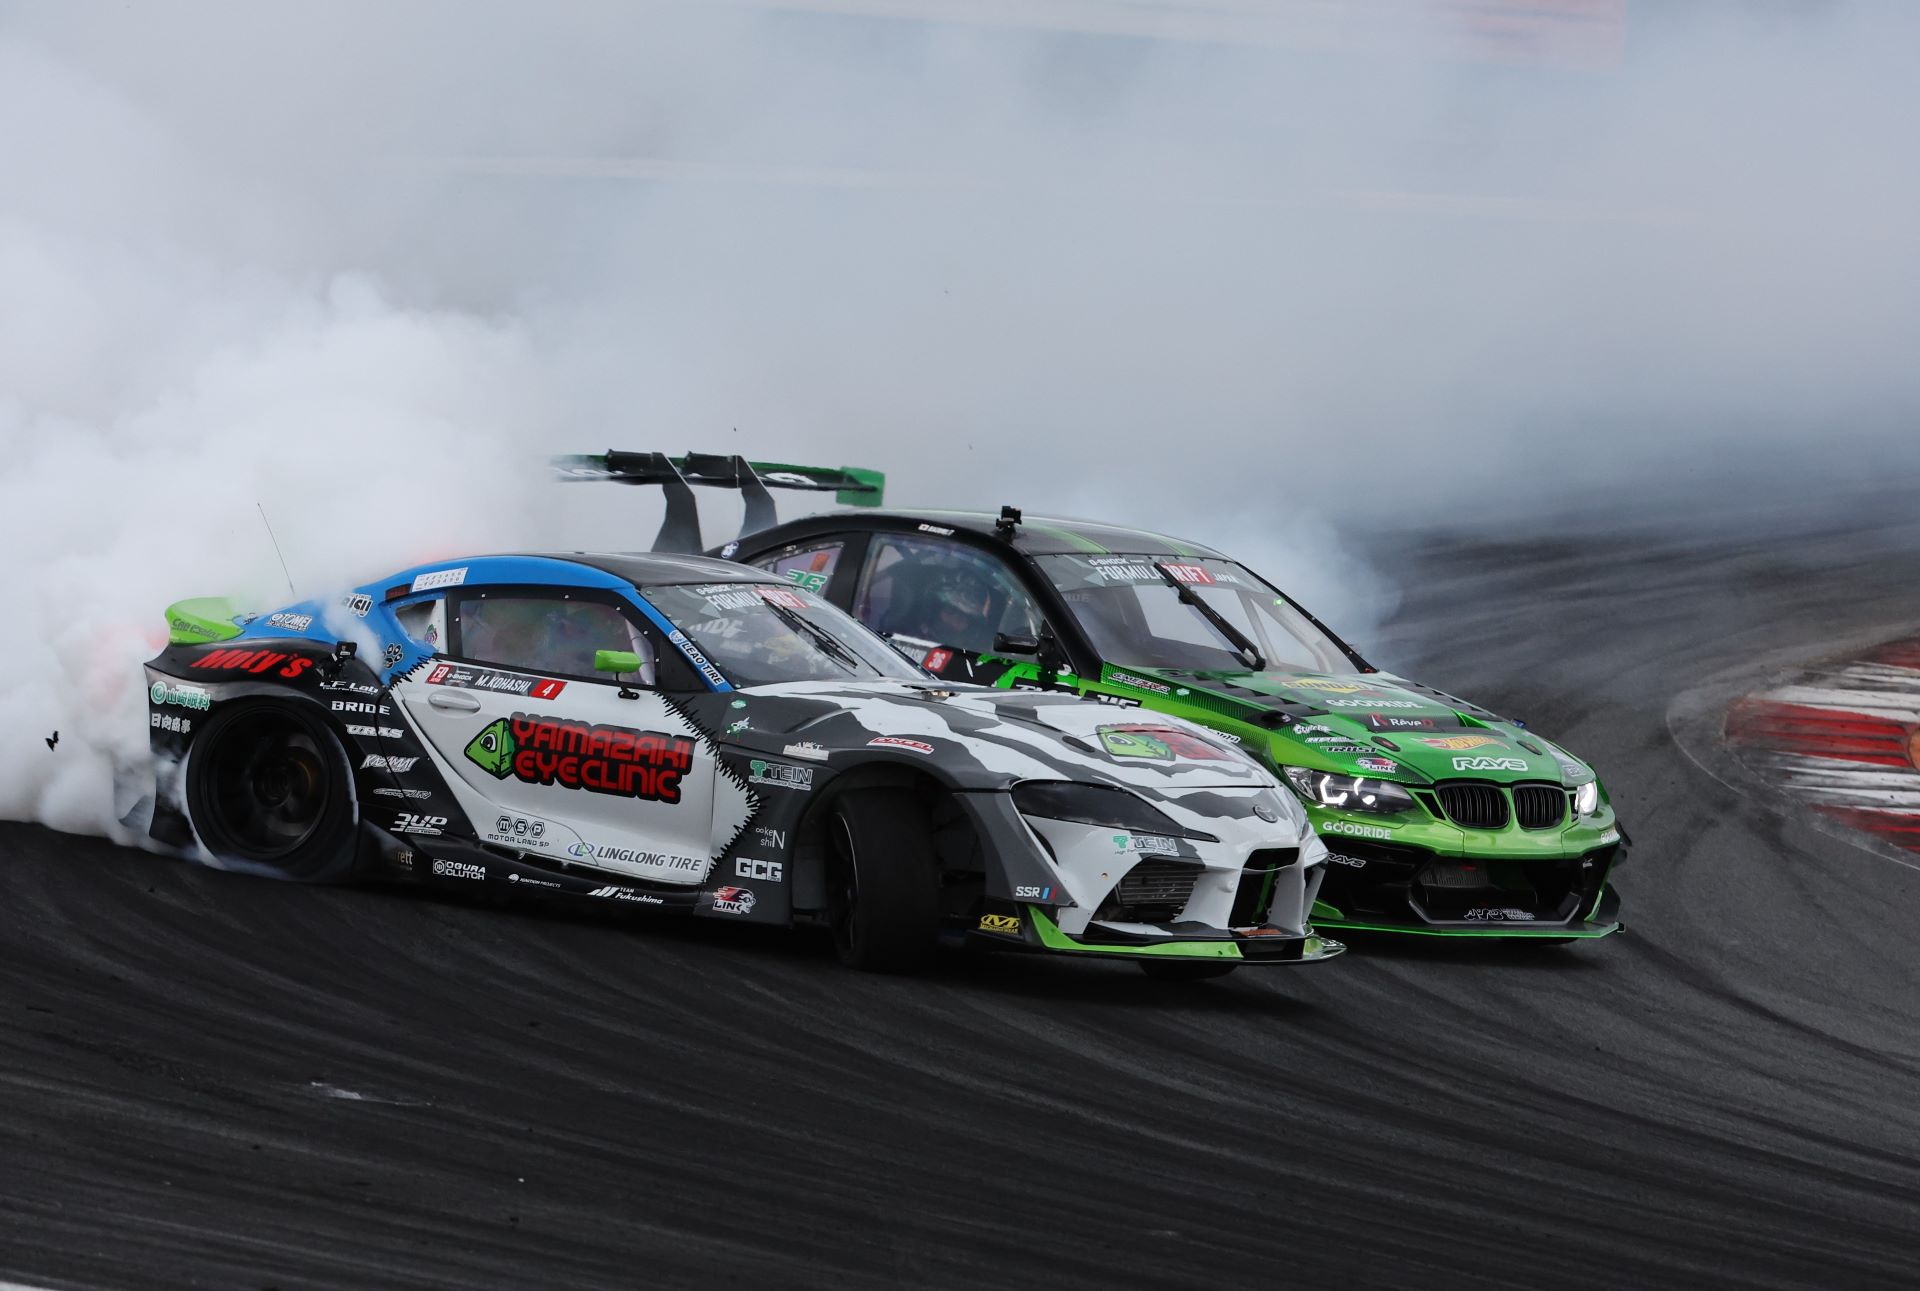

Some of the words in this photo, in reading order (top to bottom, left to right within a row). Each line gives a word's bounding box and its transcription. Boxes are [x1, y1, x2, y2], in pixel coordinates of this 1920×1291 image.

[190, 649, 312, 678] Moty's
[682, 641, 705, 664] LEAO
[702, 664, 723, 685] TIRE
[475, 675, 532, 693] M.KOHASHI
[542, 683, 555, 697] 4
[332, 700, 391, 716] BRIDE
[511, 716, 691, 769] YAMAZAKI
[1452, 757, 1529, 771] RAYS
[514, 750, 678, 799] EYECLINIC
[767, 763, 813, 784] TEIN
[488, 833, 515, 842] MOTOR
[1323, 821, 1392, 839] GOODRIDE
[1131, 836, 1178, 852] TEIN
[446, 861, 486, 873] OGURA
[596, 846, 665, 867] LINGLONG
[668, 856, 703, 871] TIRE
[445, 868, 485, 880] CLUTCH
[735, 857, 783, 882] GCG
[615, 892, 664, 904] Fukushima
[1016, 886, 1040, 897] SSR
